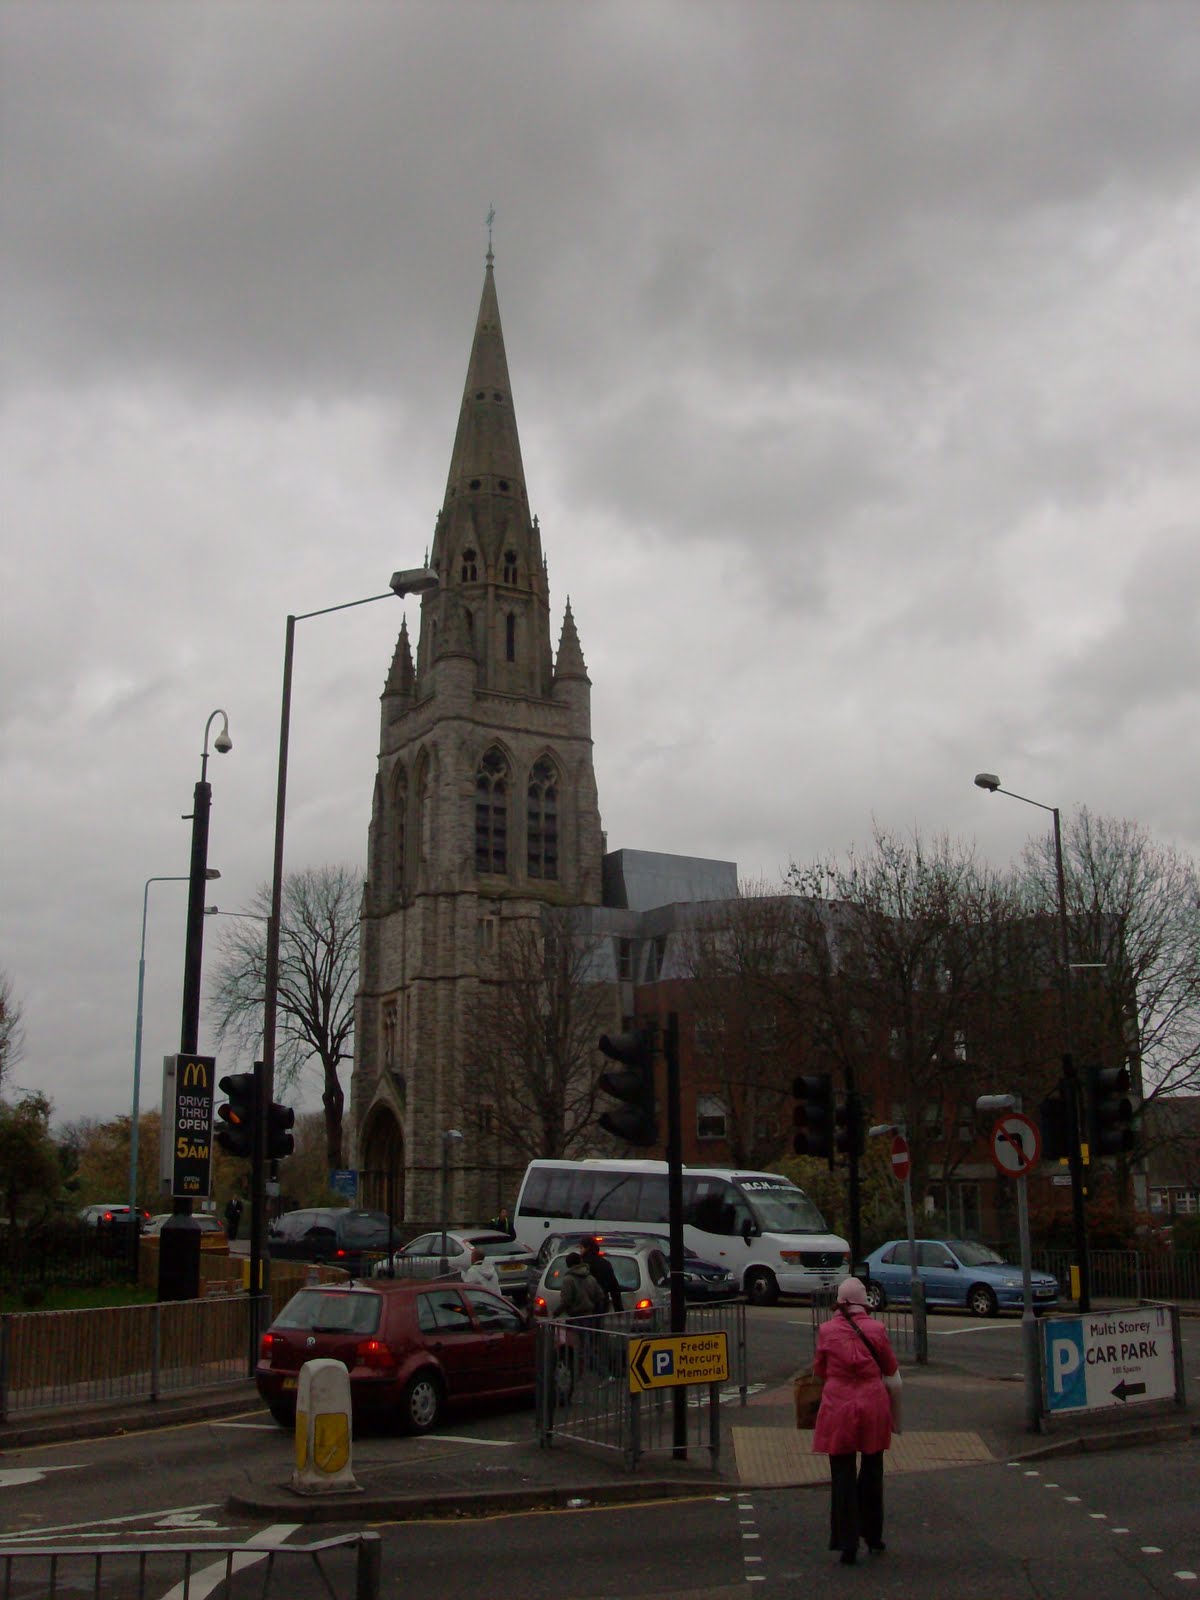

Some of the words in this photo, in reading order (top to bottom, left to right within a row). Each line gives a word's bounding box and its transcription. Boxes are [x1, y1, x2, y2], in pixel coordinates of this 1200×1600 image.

[179, 1095, 210, 1108] DRIVE
[180, 1106, 208, 1119] THRU
[178, 1119, 209, 1131] OPEN
[1090, 1321, 1117, 1337] Multi
[1118, 1321, 1151, 1334] Storey
[680, 1340, 719, 1352] Freddie
[1086, 1345, 1118, 1365] CAR
[1120, 1340, 1158, 1361] PARK
[656, 1352, 670, 1374] P
[679, 1353, 722, 1365] Mercury
[1052, 1338, 1080, 1393] P
[676, 1365, 725, 1379] Memorial
